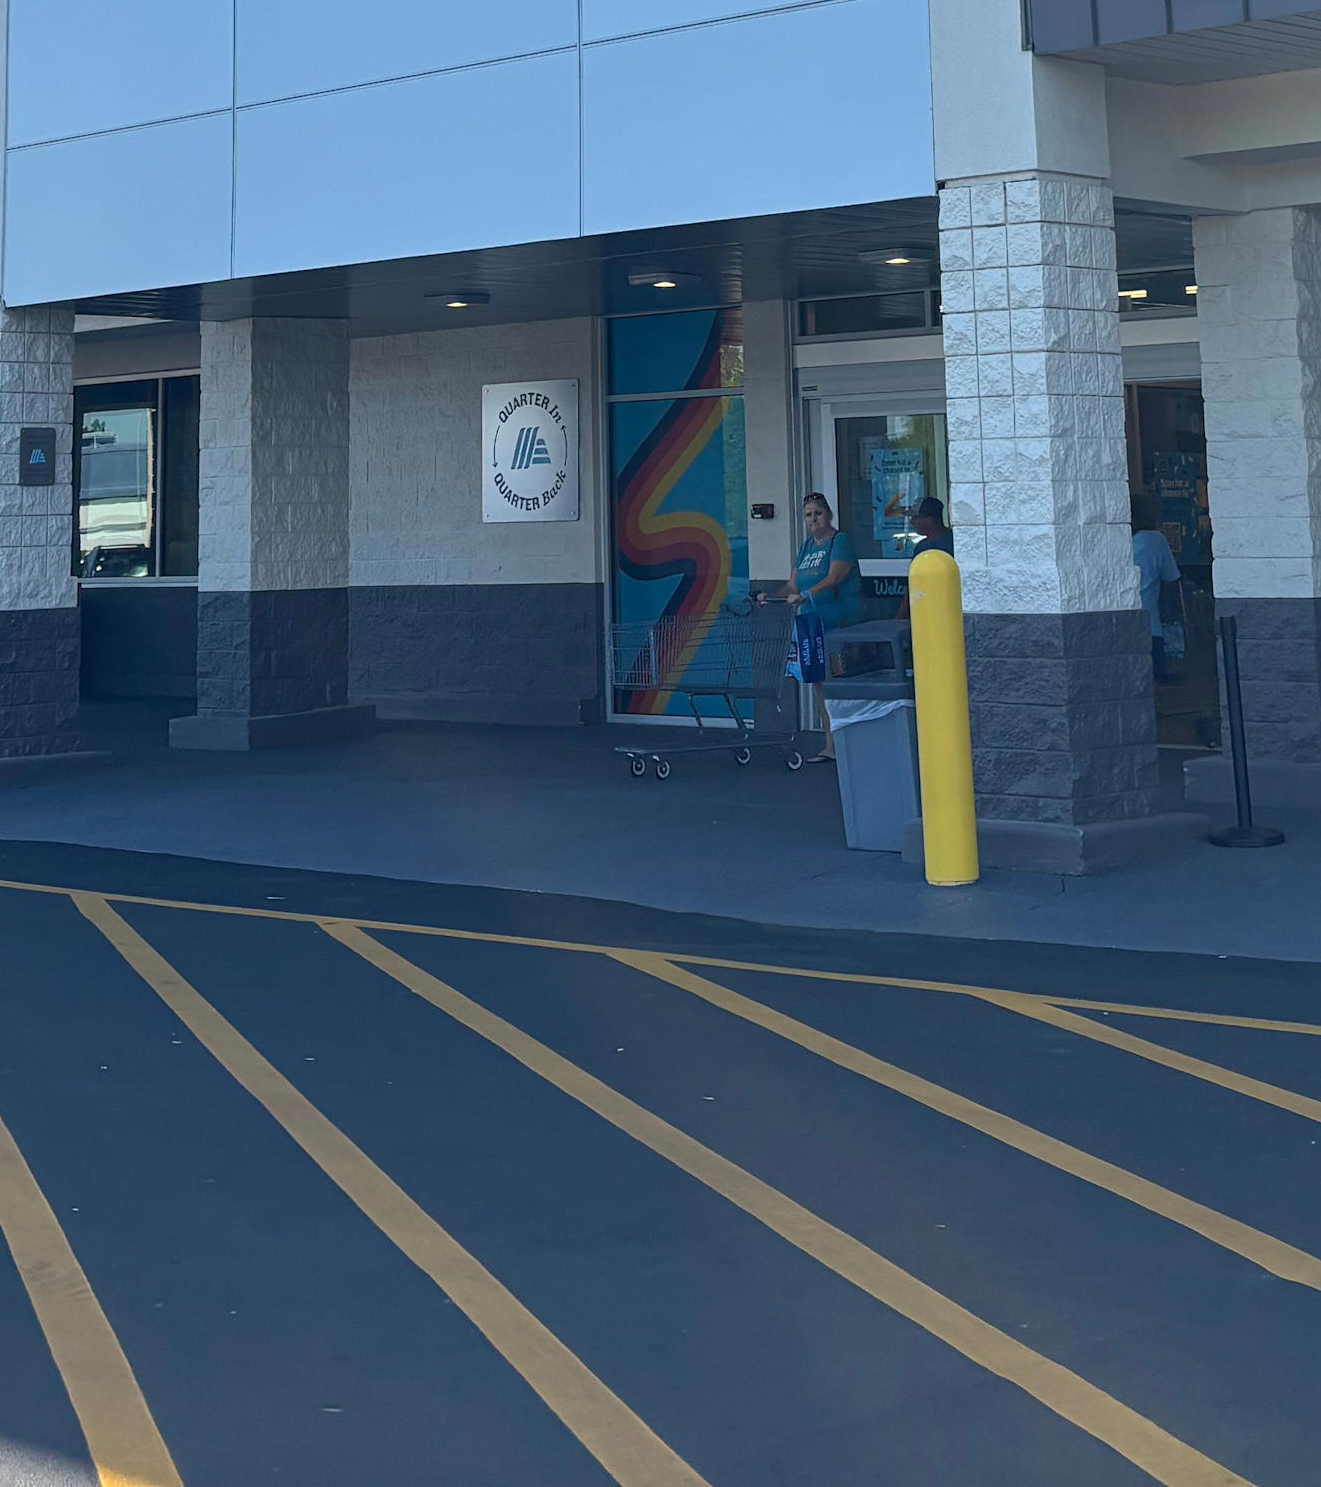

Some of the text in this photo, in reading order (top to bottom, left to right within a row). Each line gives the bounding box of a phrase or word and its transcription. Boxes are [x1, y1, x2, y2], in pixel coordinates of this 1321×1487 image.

[498, 392, 562, 425] QUARTER In
[494, 469, 567, 512] QUARTER Back
[873, 577, 909, 596] Welc
